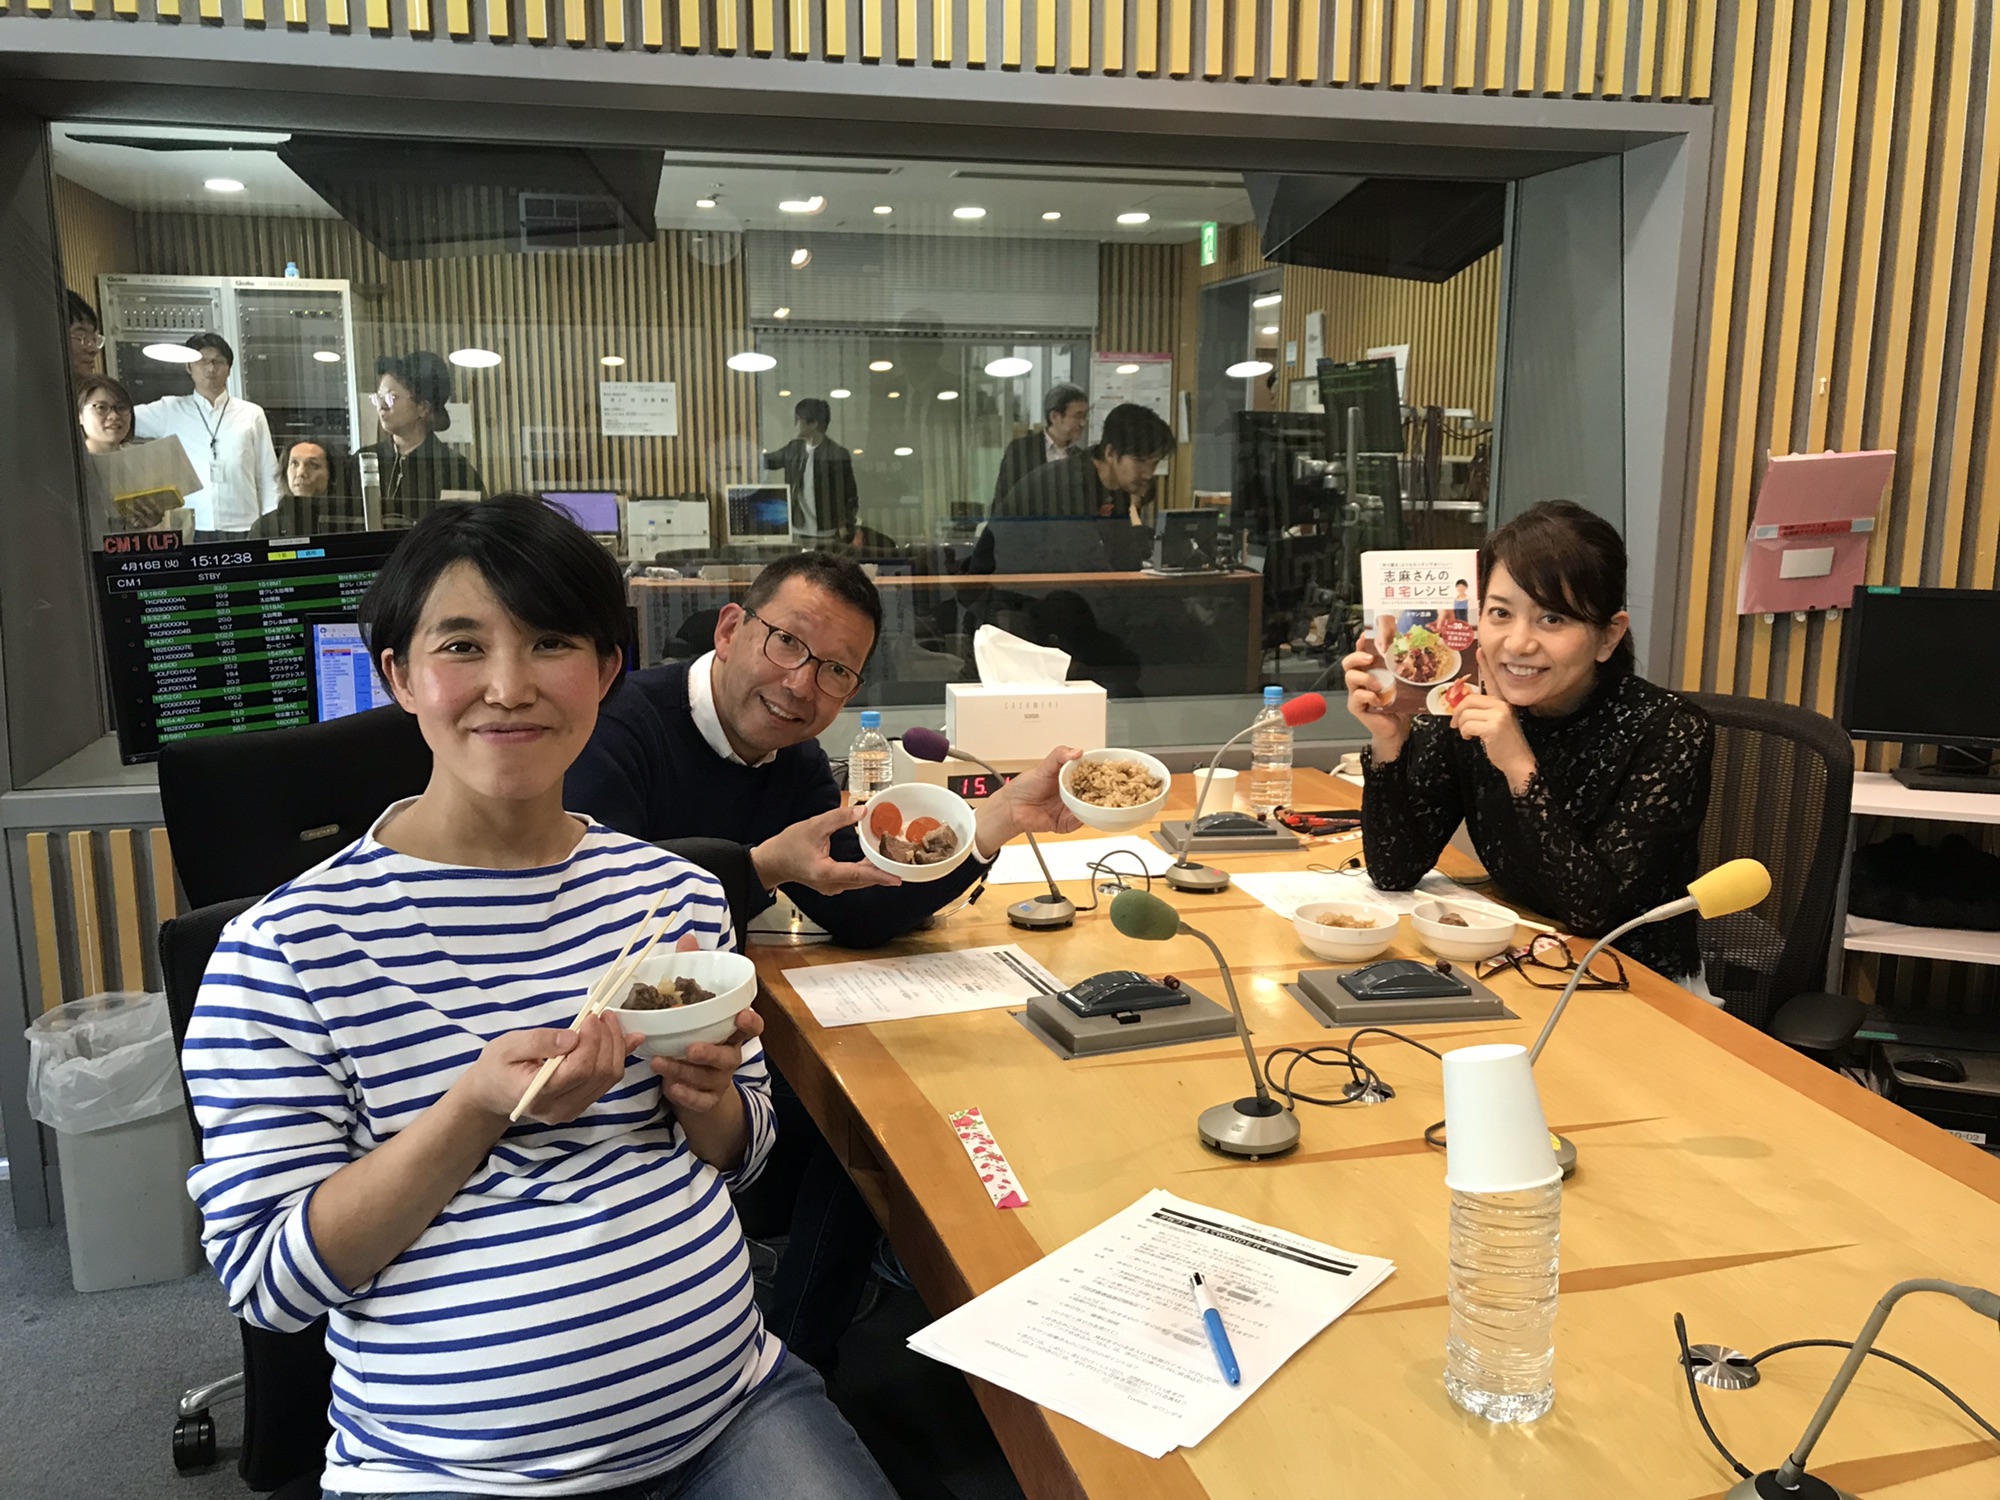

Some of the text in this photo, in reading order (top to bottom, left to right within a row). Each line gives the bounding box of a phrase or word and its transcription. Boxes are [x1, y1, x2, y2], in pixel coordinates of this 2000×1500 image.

[104, 533, 179, 554] CM1 (LF)
[121, 560, 160, 572] 4月16日
[190, 552, 252, 567] 15:12:38
[117, 572, 221, 588] CM1 STBY
[1384, 570, 1449, 582] 志麻さんの
[1385, 586, 1450, 598] 自宅レシピ
